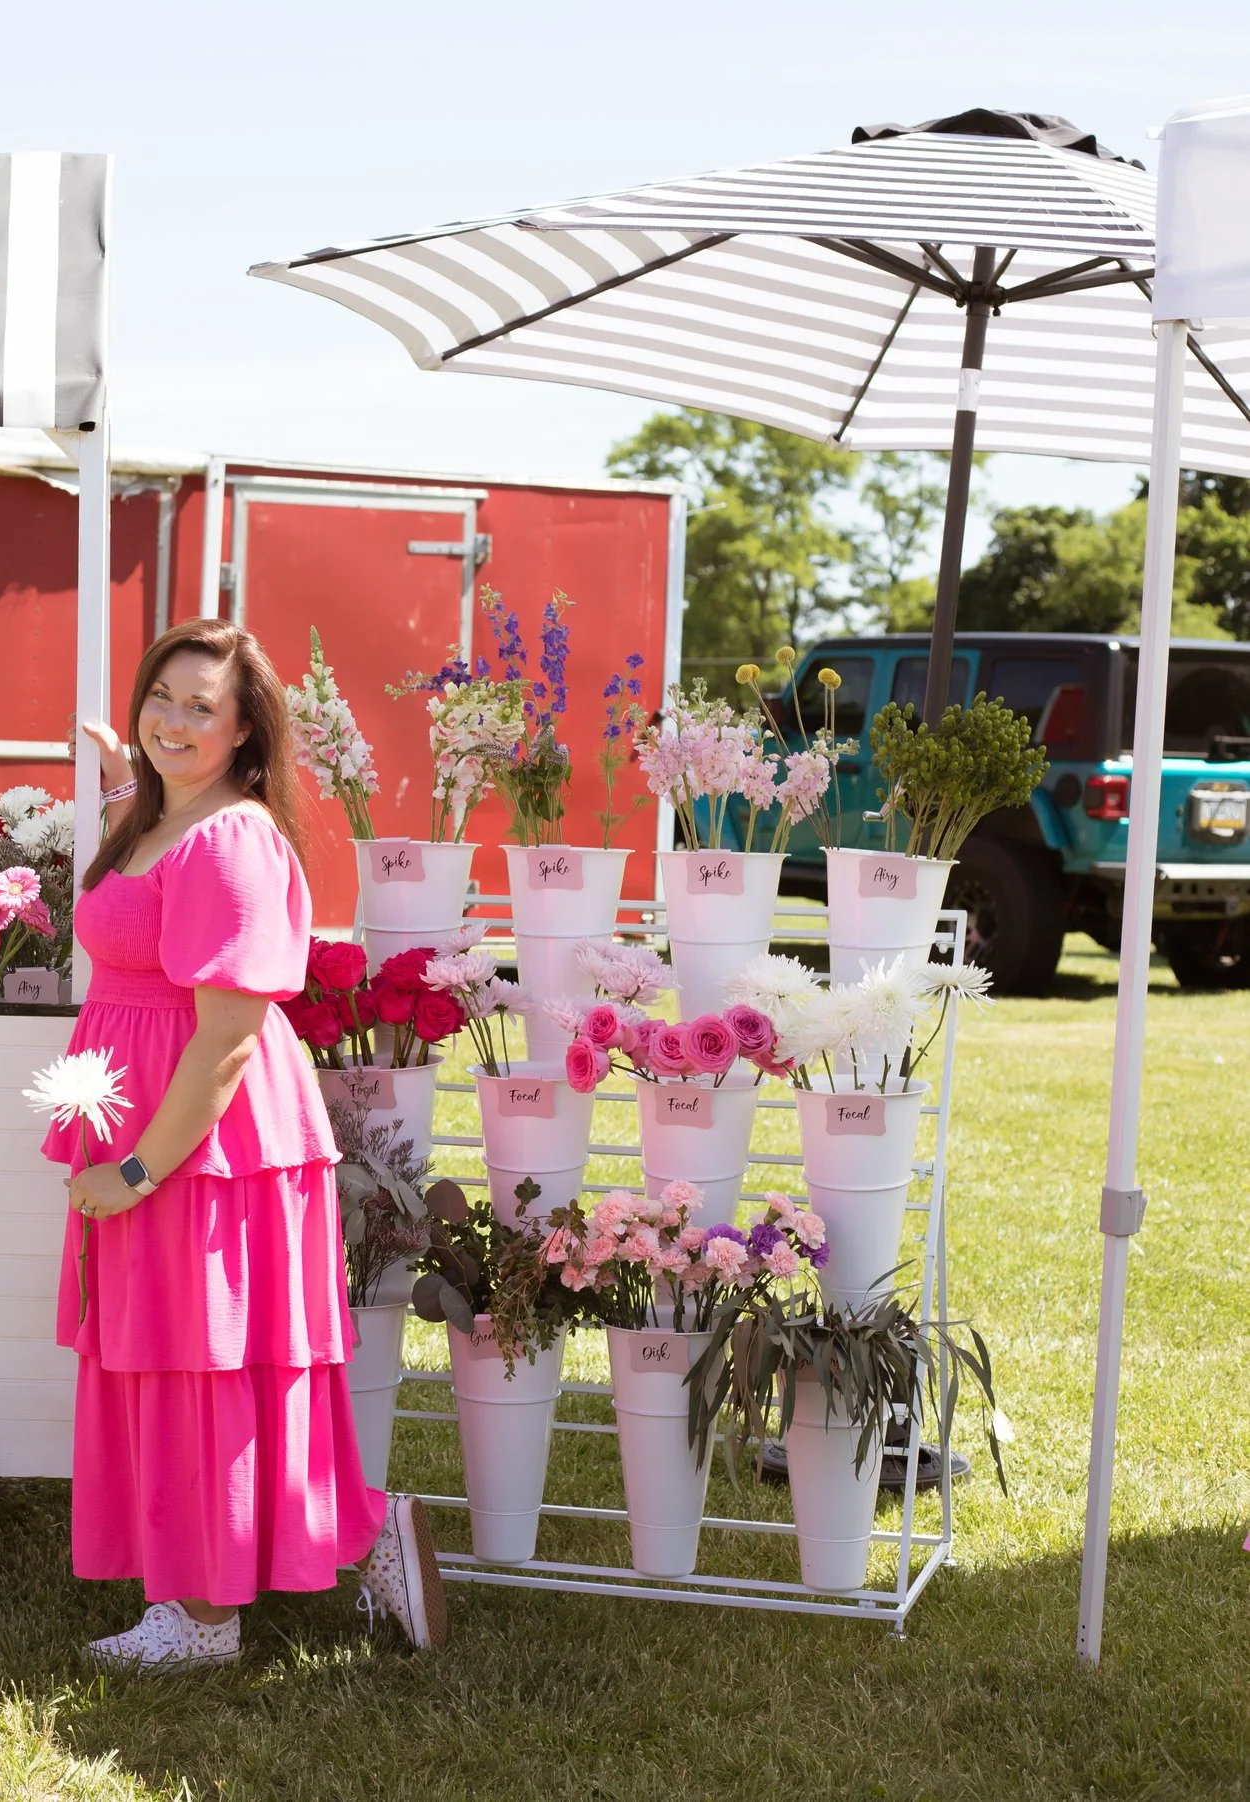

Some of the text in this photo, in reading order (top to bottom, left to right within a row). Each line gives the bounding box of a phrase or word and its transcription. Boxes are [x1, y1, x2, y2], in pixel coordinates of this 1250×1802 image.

[382, 851, 411, 876] Spike
[539, 857, 570, 882] Spike
[699, 861, 731, 886] Spike
[873, 867, 899, 890] Airy
[18, 980, 41, 1000] Airy
[509, 1088, 541, 1104] Focal
[667, 1097, 699, 1113] Focal
[837, 1105, 871, 1122] Focal
[642, 1342, 671, 1361] Disk
